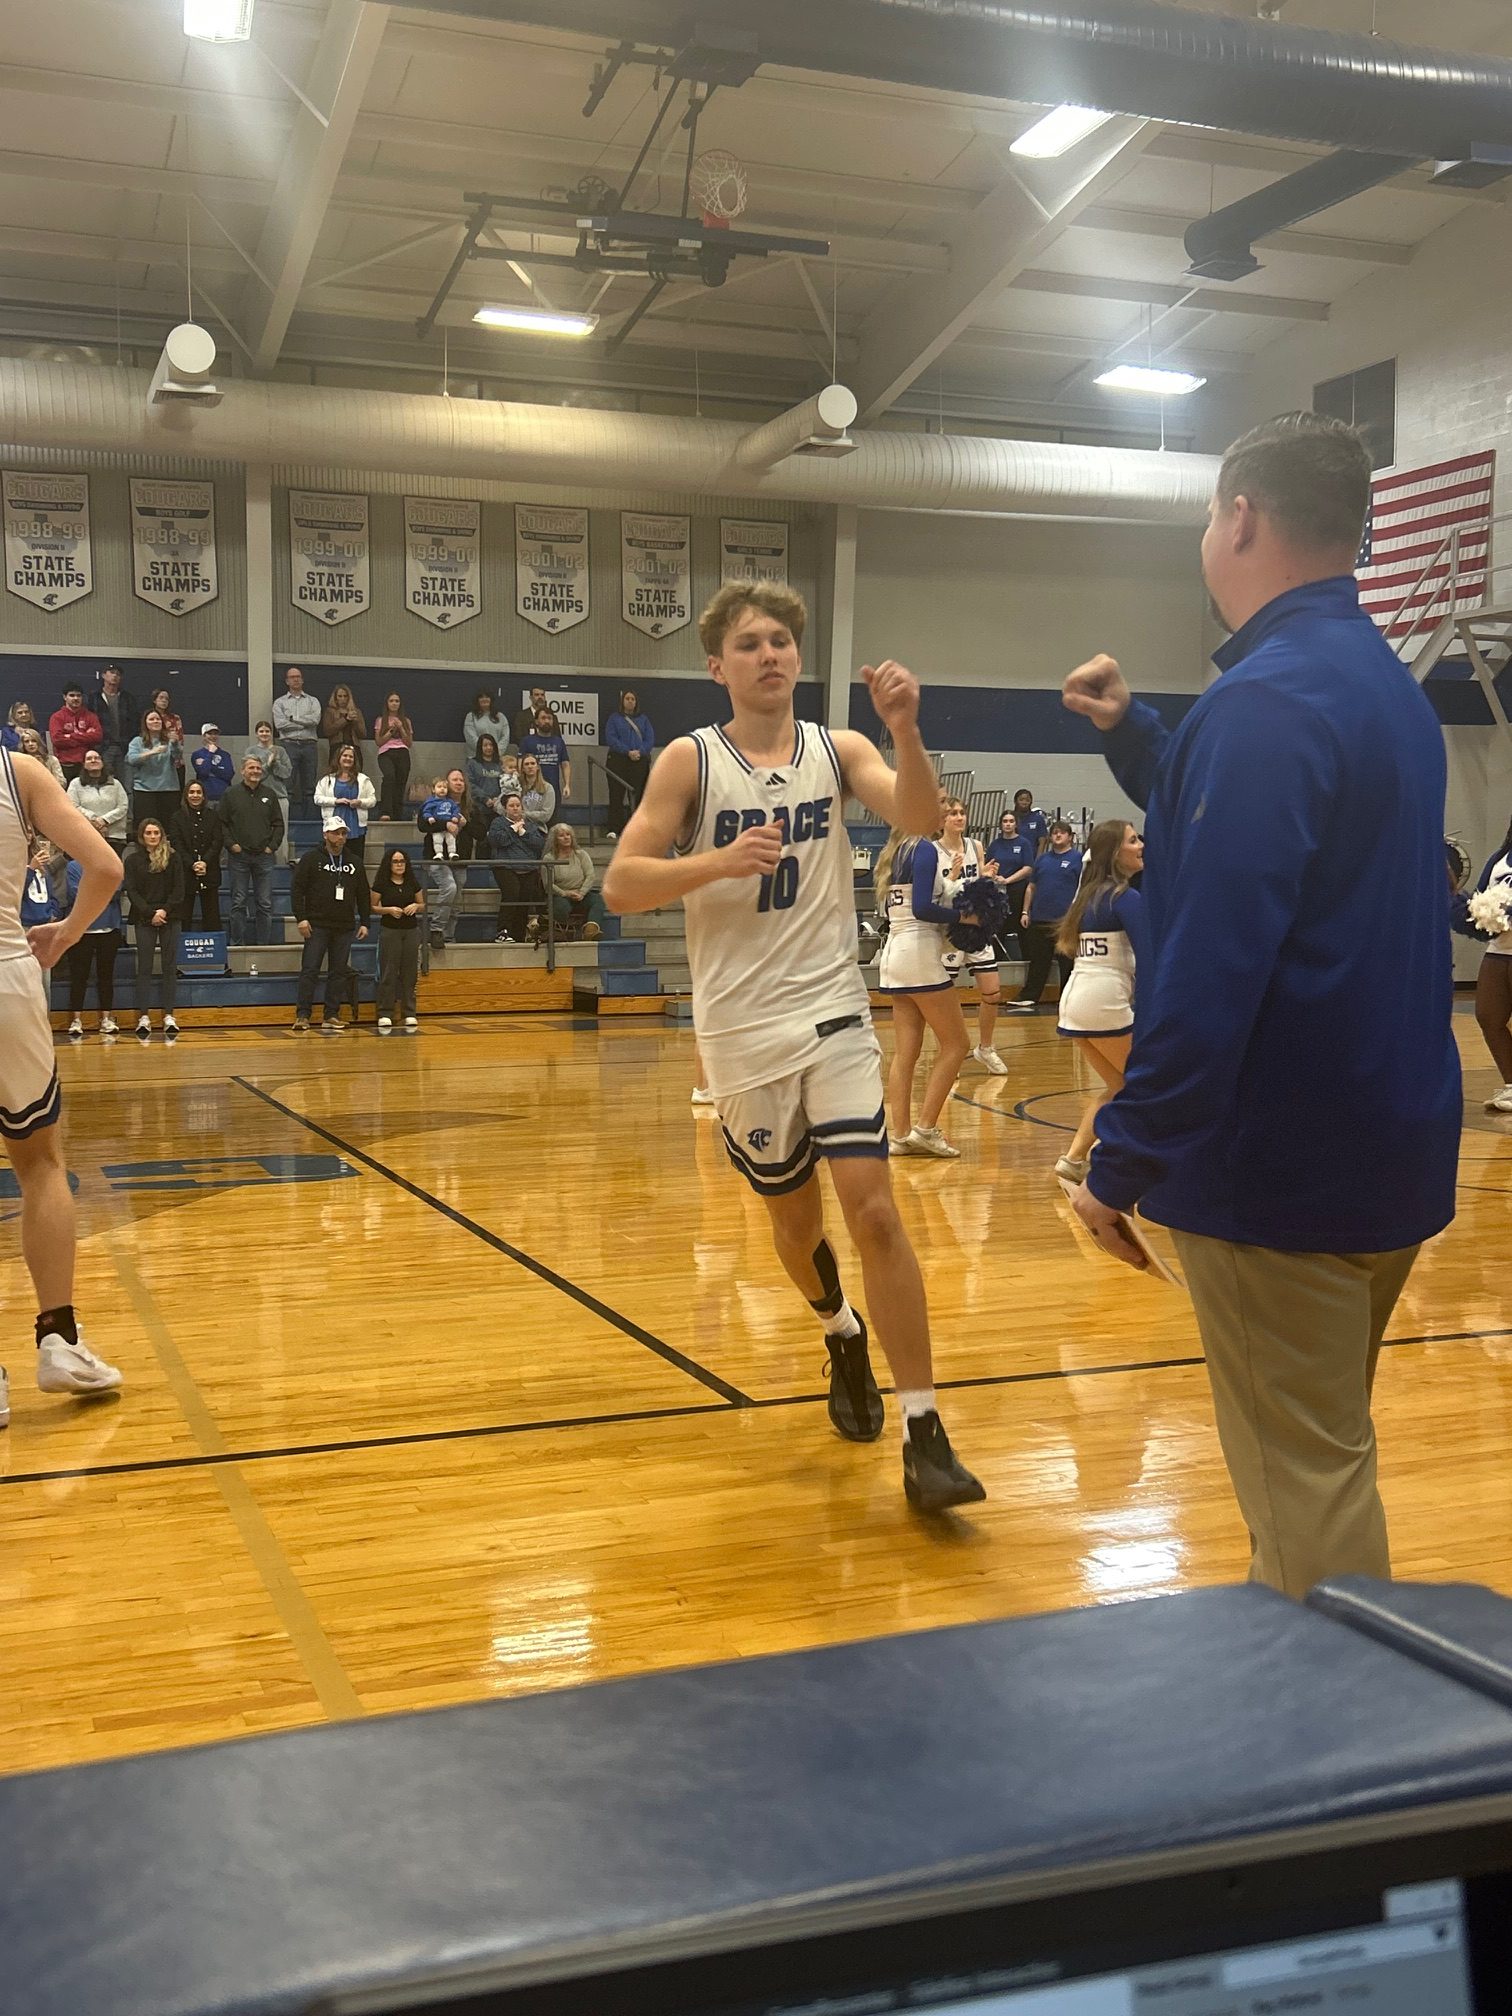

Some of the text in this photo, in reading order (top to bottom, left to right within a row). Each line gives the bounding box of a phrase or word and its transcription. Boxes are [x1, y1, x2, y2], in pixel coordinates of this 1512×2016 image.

[7, 481, 86, 499] COUGARS
[135, 488, 210, 507] COUGARS
[293, 502, 365, 520] COUGARS
[408, 506, 478, 525] COUGARS
[10, 520, 86, 540] 1998-99
[519, 515, 585, 533] COUGARS
[137, 527, 211, 546] 1998-99
[31, 543, 60, 551] DIVISION
[295, 538, 365, 557] 1999-00
[409, 543, 476, 562] 1999-00
[22, 555, 75, 571] STATE
[520, 550, 585, 569] 2001-02
[625, 557, 687, 575] 2001-02
[150, 561, 201, 577] STATE
[14, 570, 86, 587] CHAMPS
[142, 576, 211, 593] CHAMPS
[306, 571, 354, 587] STATE
[420, 576, 466, 592] STATE
[299, 586, 364, 603] CHAMPS
[530, 582, 575, 598] STATE
[635, 588, 677, 603] STATE
[412, 590, 475, 608] CHAMPS
[522, 596, 584, 613] CHAMPS
[628, 602, 686, 618] CHAMPS
[548, 700, 585, 714] OME
[558, 723, 595, 736] TING
[942, 863, 977, 879] GACE
[758, 856, 799, 912] 10
[184, 938, 215, 946] COUGAR
